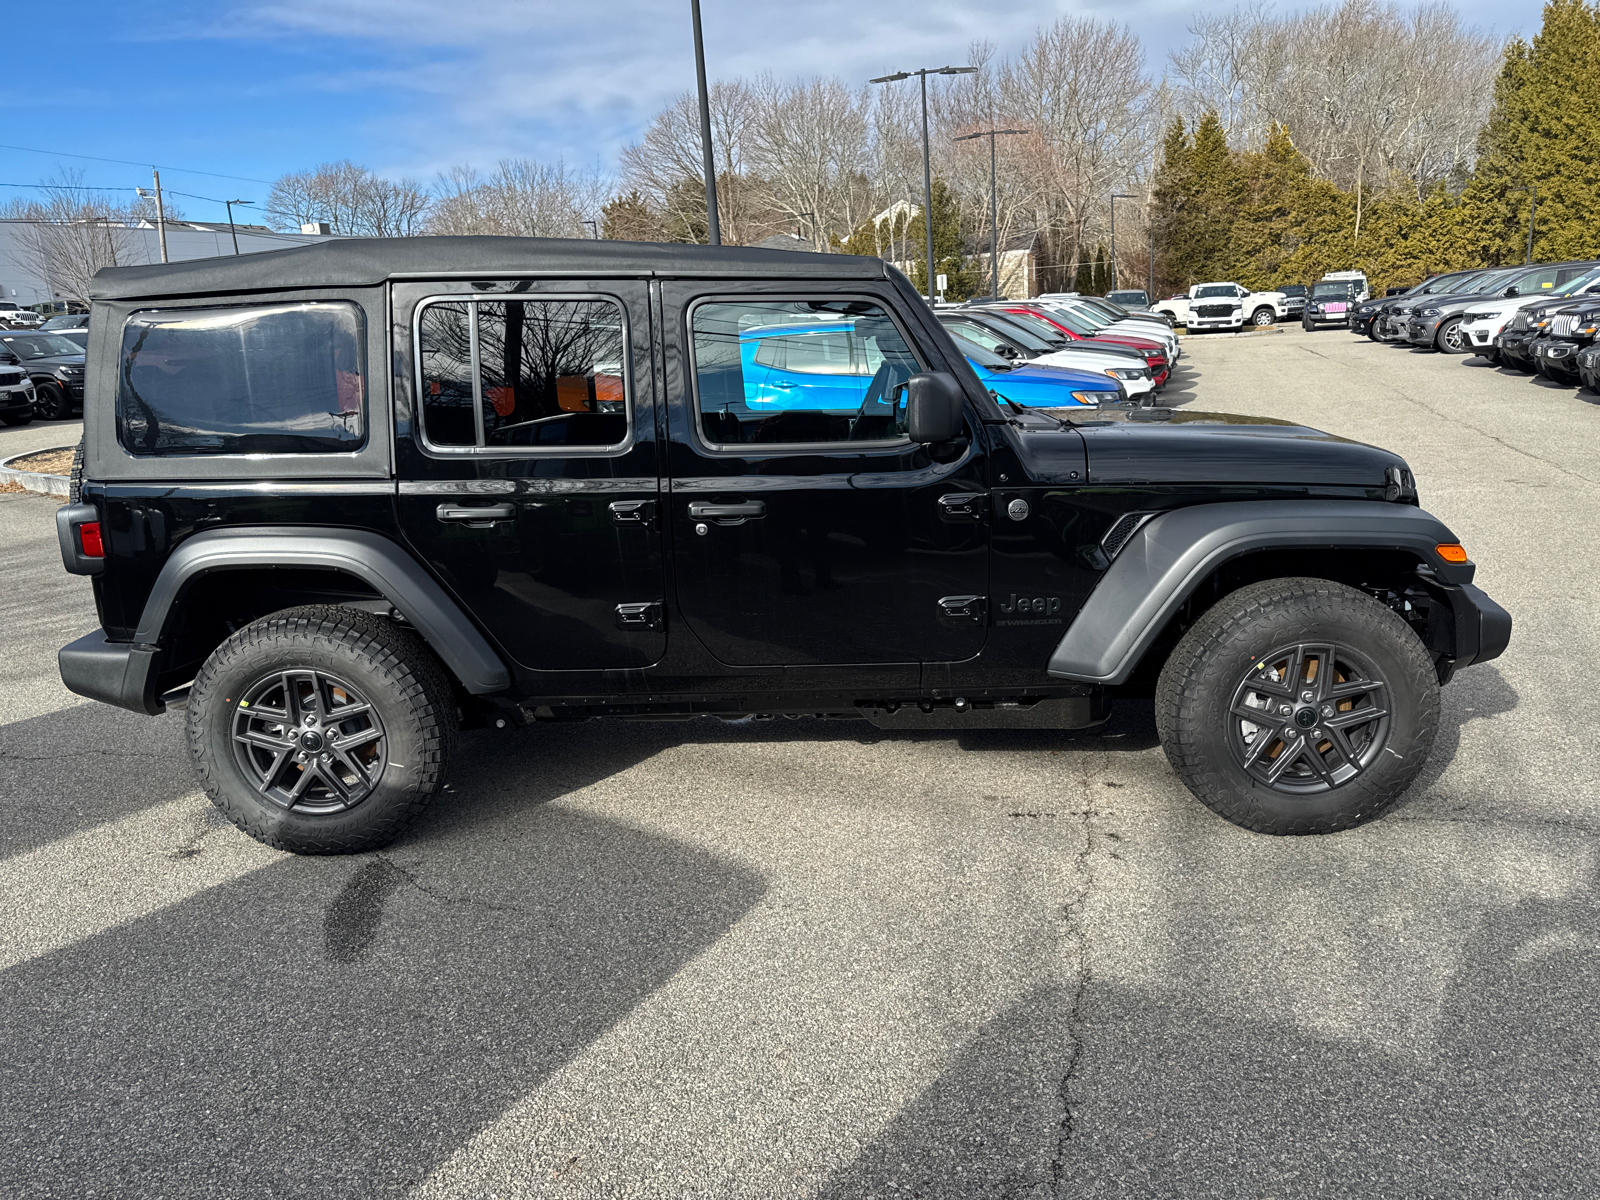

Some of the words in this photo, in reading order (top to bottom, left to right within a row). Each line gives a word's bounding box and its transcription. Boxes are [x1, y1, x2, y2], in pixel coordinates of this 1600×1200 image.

[1000, 593, 1060, 615] Jeep
[1007, 618, 1062, 626] WRANGLER
[236, 650, 333, 680] NEXEN
